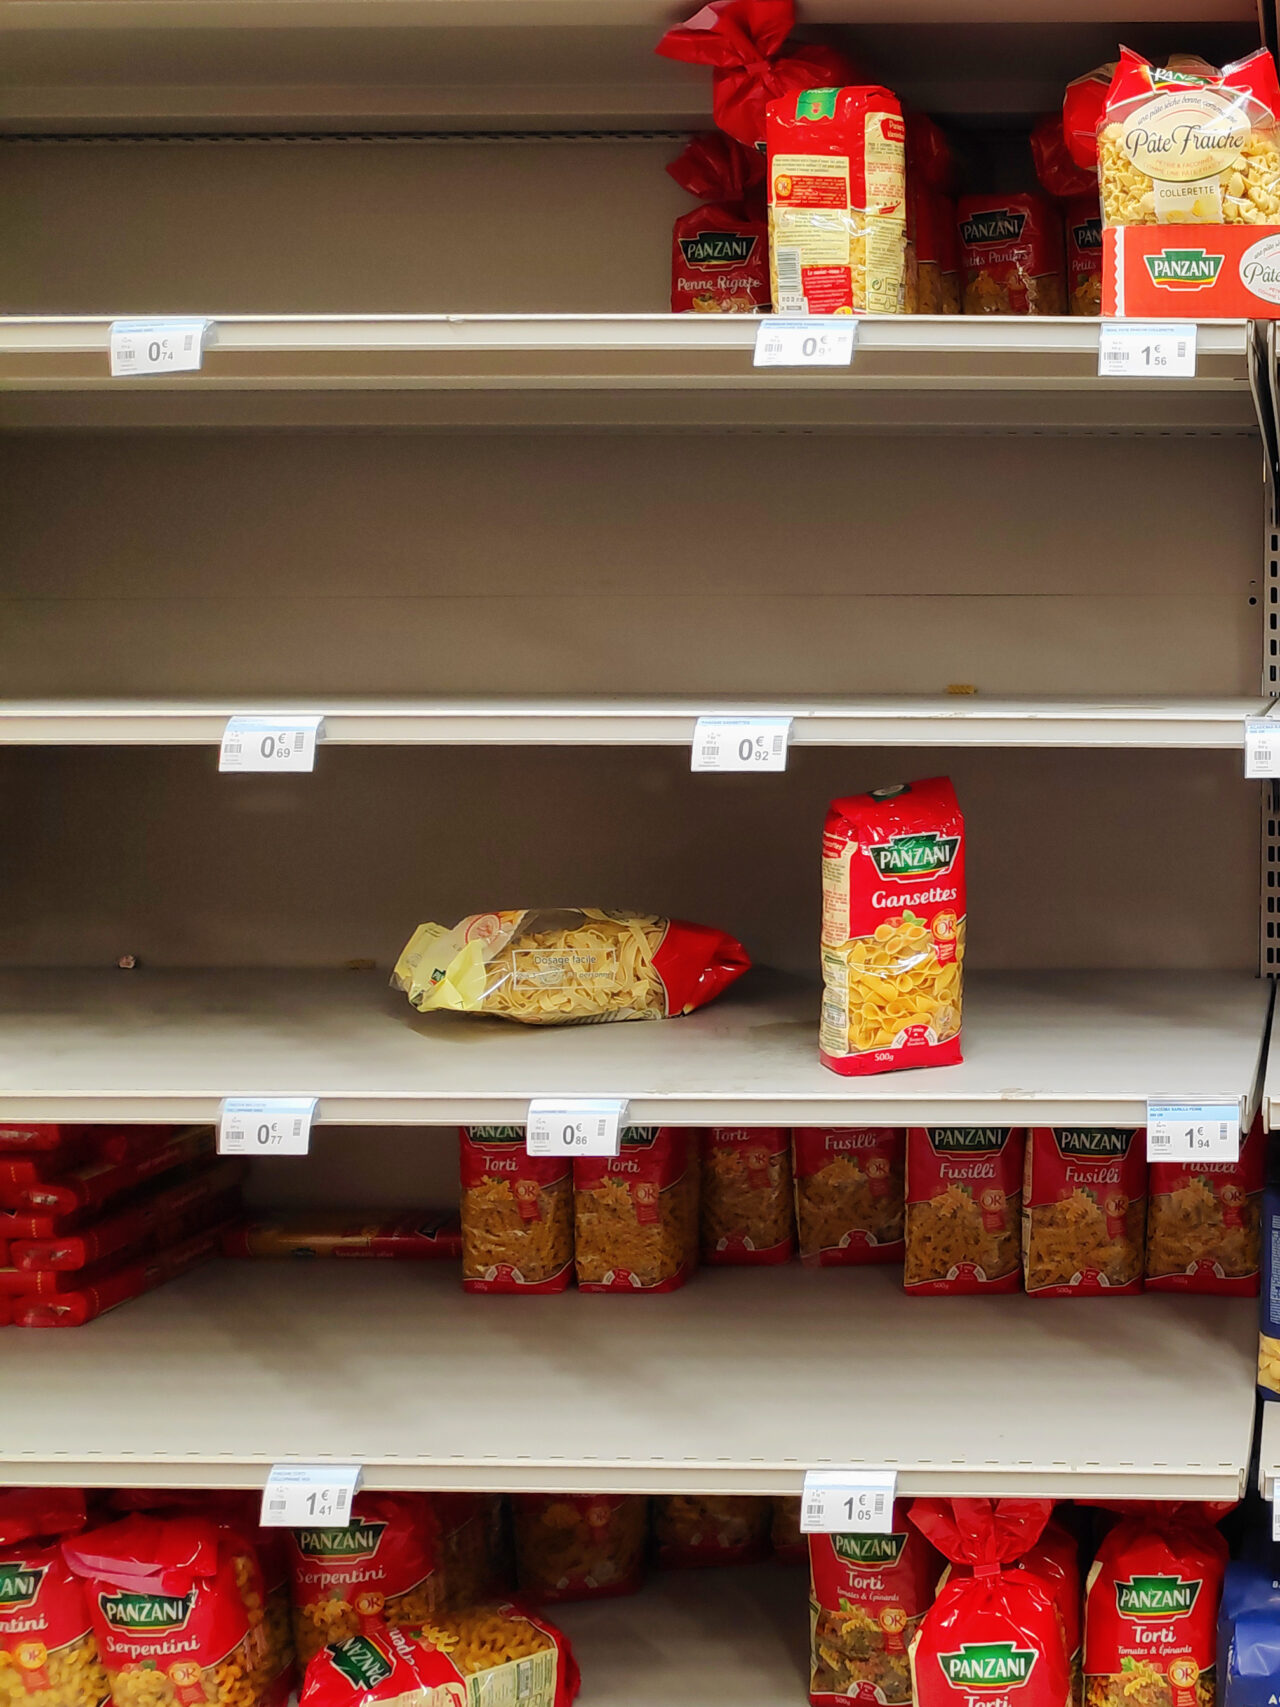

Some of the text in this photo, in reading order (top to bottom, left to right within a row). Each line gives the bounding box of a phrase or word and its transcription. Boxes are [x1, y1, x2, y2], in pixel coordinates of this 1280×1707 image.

[1126, 128, 1172, 159] Pâte
[1159, 186, 1215, 198] COLLERETTE
[963, 220, 1019, 239] PANZANI
[687, 241, 747, 258] PANZANI
[1153, 259, 1216, 277] PANZANI
[677, 276, 713, 292] Penne
[148, 342, 160, 361] 0
[802, 338, 817, 356] 0
[1141, 346, 1150, 366] 1
[261, 736, 275, 758] 0
[739, 739, 753, 761] 0
[880, 845, 950, 870] PANZANI
[871, 886, 957, 909] Gansettes
[934, 919, 955, 935] OR
[534, 954, 597, 965] Dosage facile
[874, 1052, 894, 1062] 500g
[257, 1124, 269, 1144] 0
[563, 1125, 575, 1145] 0
[824, 1130, 876, 1150] Fusilli
[934, 1128, 1001, 1146] PANZANI
[1061, 1131, 1127, 1150] PANZANI
[1185, 1128, 1194, 1148] 1
[482, 1156, 520, 1171] Torti
[606, 1157, 641, 1173] Torti
[939, 1162, 996, 1180] Fusilli
[1065, 1166, 1121, 1184] Fusilli
[306, 1492, 316, 1515] 1
[844, 1497, 854, 1520] 1
[300, 1529, 374, 1550] PANZANI
[836, 1535, 897, 1557] PANZANI
[297, 1564, 387, 1589] Serpentini
[846, 1570, 885, 1591] Torti
[1120, 1587, 1191, 1608] PANZANI
[106, 1601, 184, 1622] PANZANI
[1131, 1625, 1176, 1644] Torti
[106, 1634, 200, 1659] Serpentini
[1117, 1645, 1147, 1656] Tomates
[1158, 1644, 1193, 1657] Épinards
[949, 1657, 1026, 1679] PANZANI
